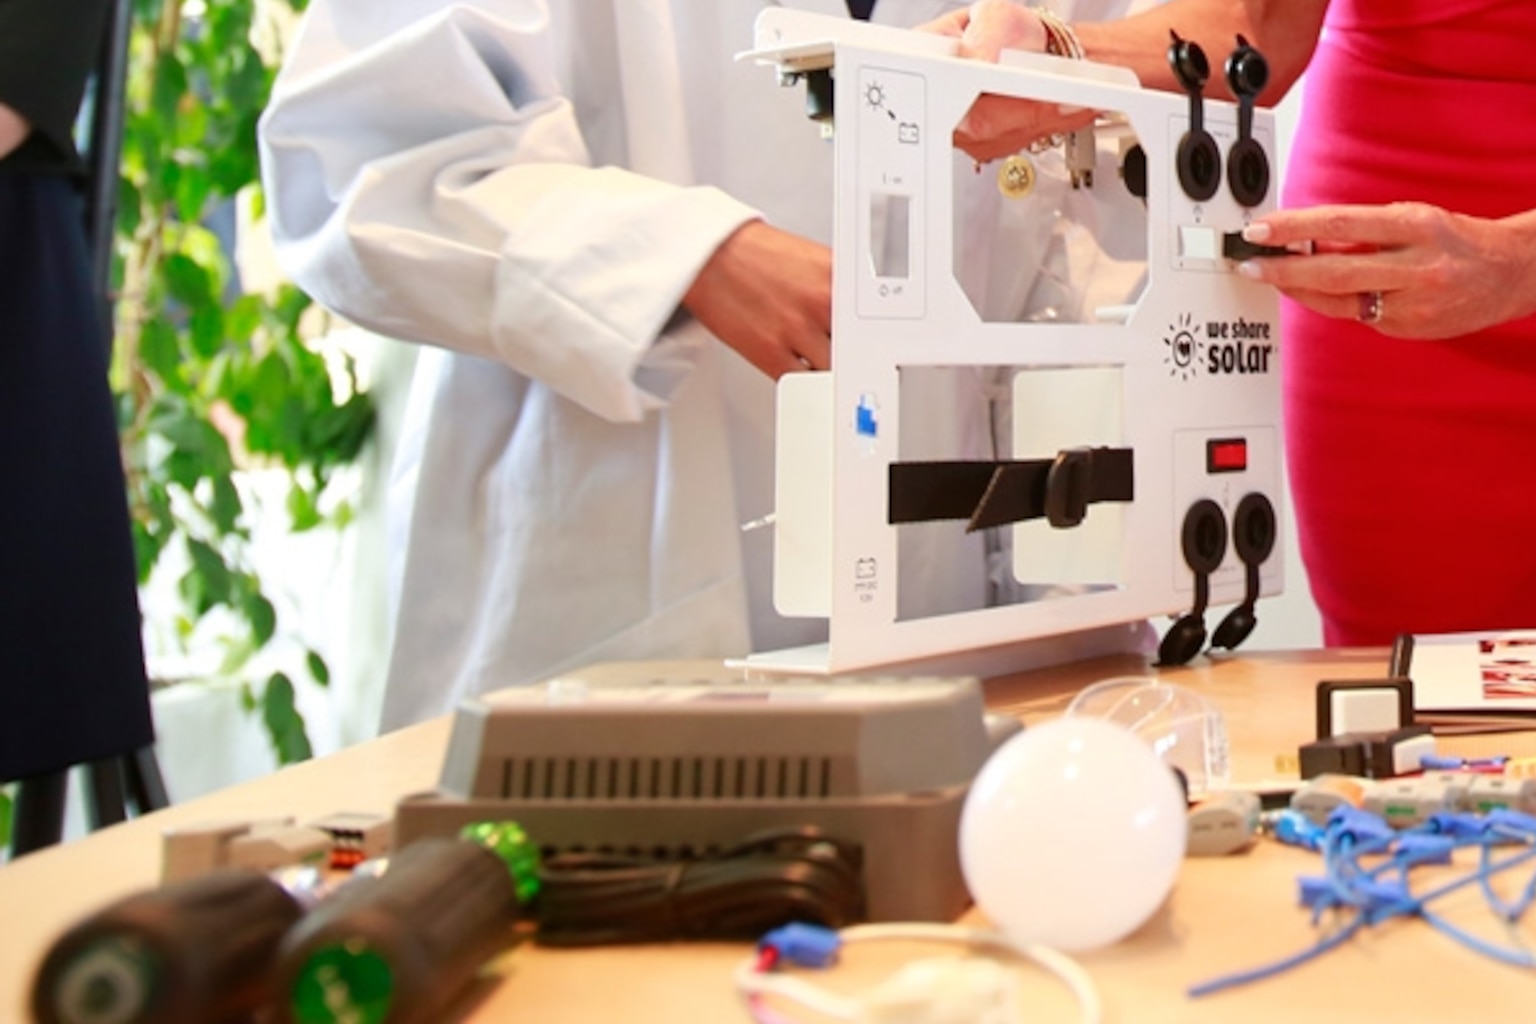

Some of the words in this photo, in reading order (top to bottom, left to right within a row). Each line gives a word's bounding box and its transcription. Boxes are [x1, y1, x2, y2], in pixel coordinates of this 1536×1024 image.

[1207, 322, 1228, 338] we
[1232, 317, 1270, 339] share
[1208, 341, 1272, 373] solar
